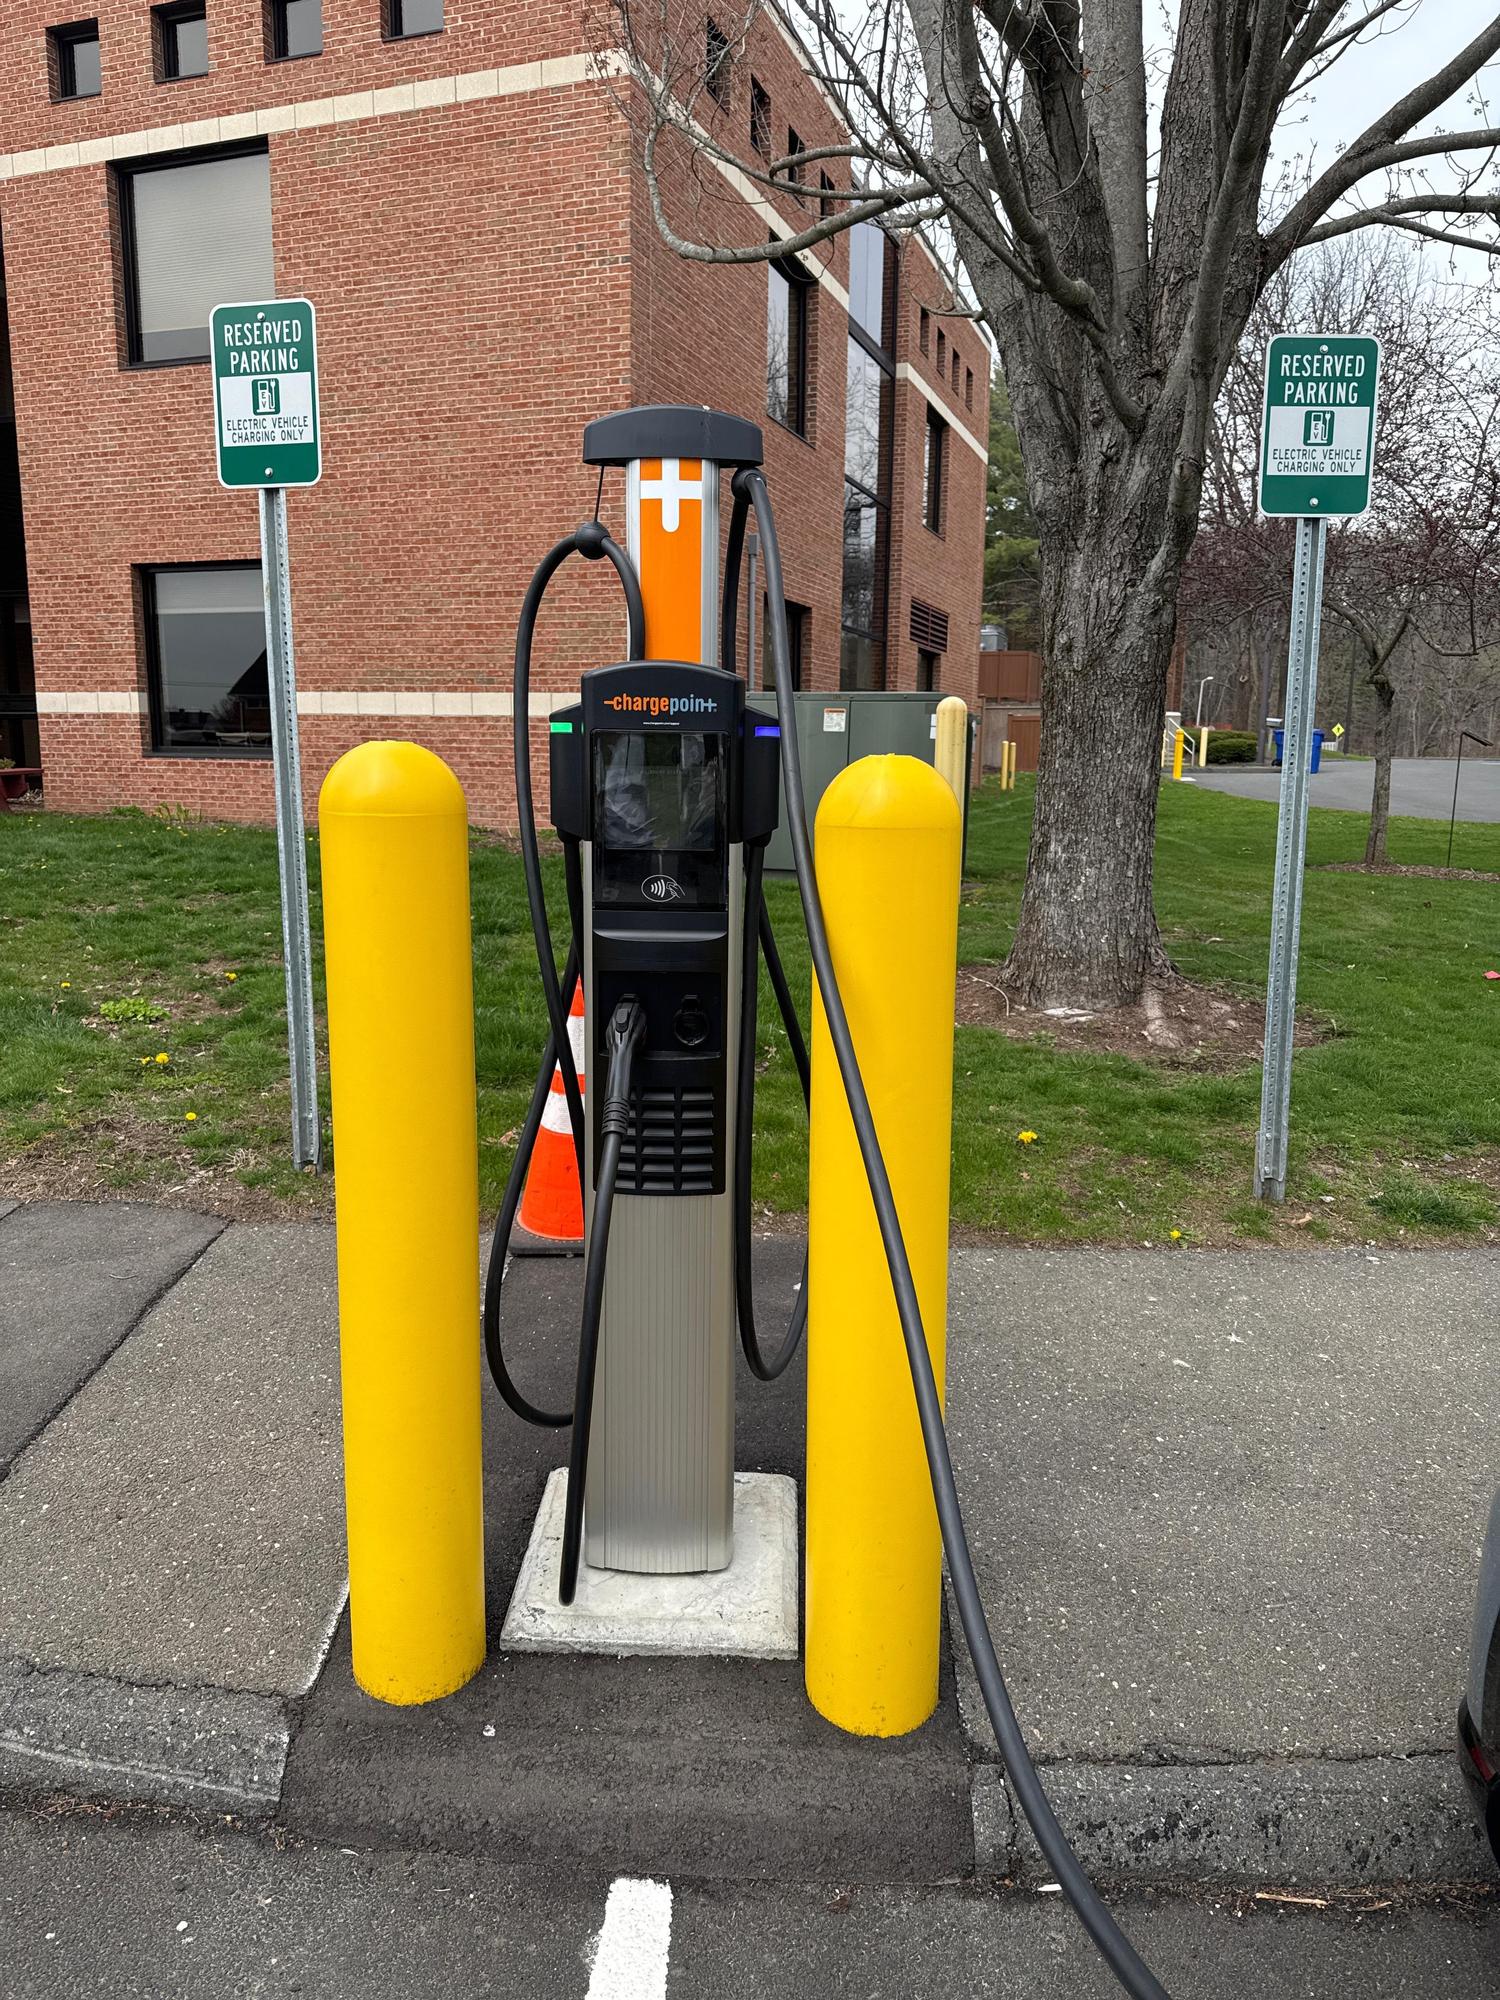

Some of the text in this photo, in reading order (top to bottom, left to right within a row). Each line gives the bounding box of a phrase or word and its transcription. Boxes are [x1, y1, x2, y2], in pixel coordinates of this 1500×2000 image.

[224, 320, 301, 346] RESERVED
[230, 348, 299, 374] PARKING
[1280, 354, 1365, 377] RESERVED
[1284, 381, 1359, 404] PARKING
[226, 415, 309, 431] ELECTRIC VEHICLE
[232, 429, 304, 444] CHARGING ONLY
[1272, 449, 1362, 461] ELECTRIC VEHICLE
[1277, 461, 1357, 473] CHARGING ONLY
